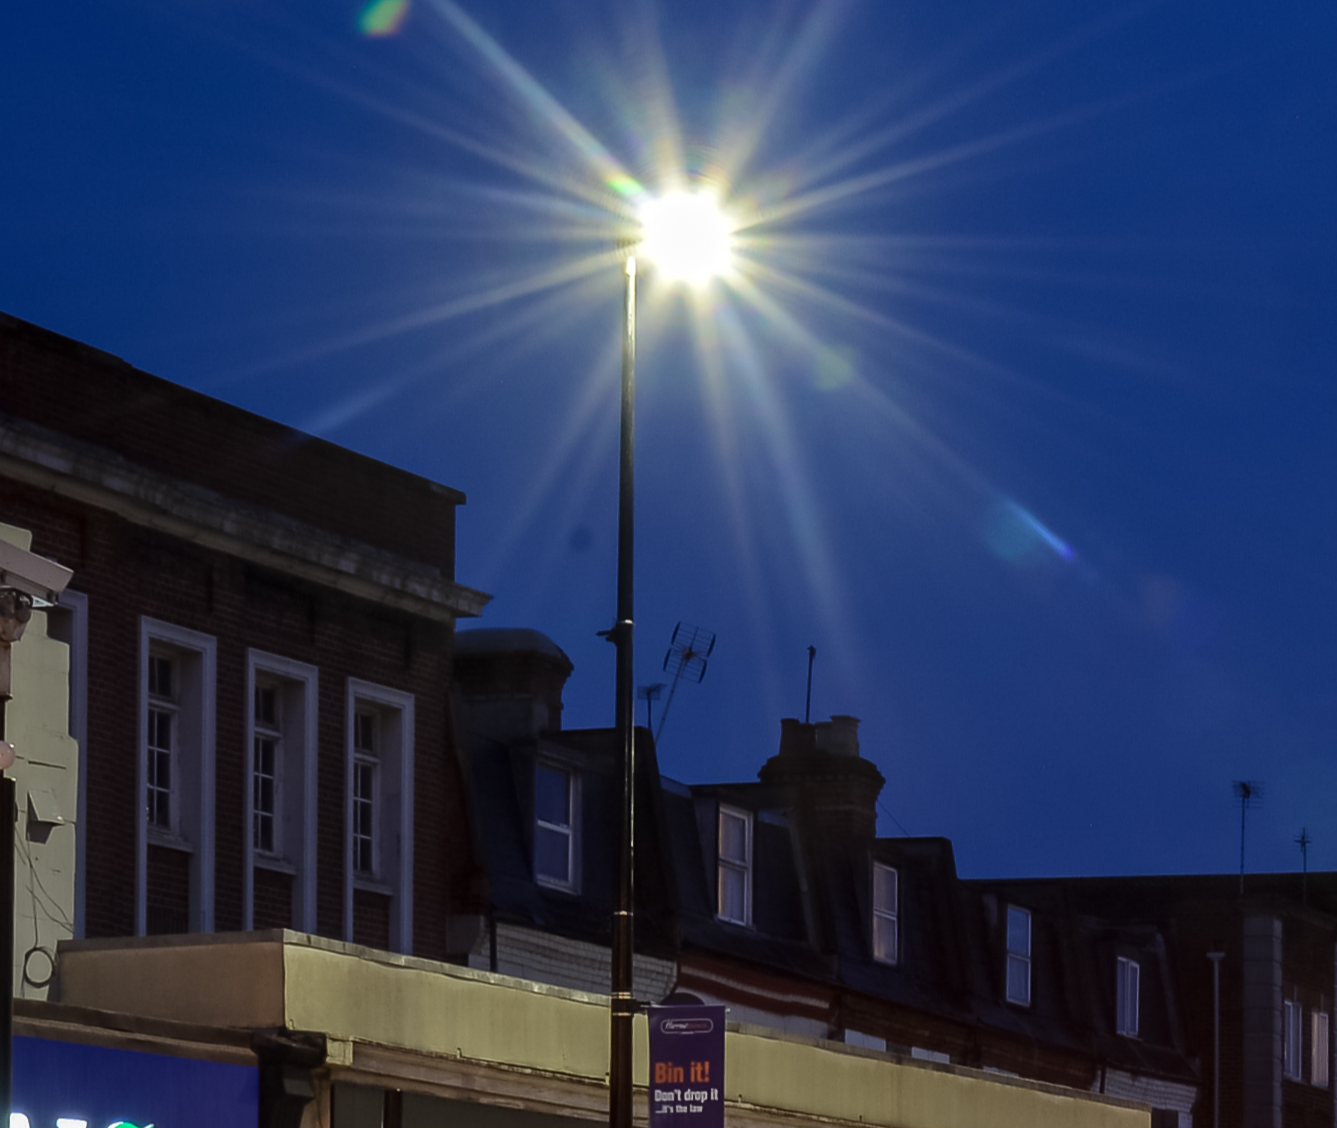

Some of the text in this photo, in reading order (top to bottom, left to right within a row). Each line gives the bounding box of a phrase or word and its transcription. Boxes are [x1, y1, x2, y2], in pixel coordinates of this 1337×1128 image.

[655, 1061, 711, 1084] Bin it!
[654, 1088, 718, 1103] Don't drop it
[676, 1104, 687, 1113] the
[690, 1104, 703, 1113] law
